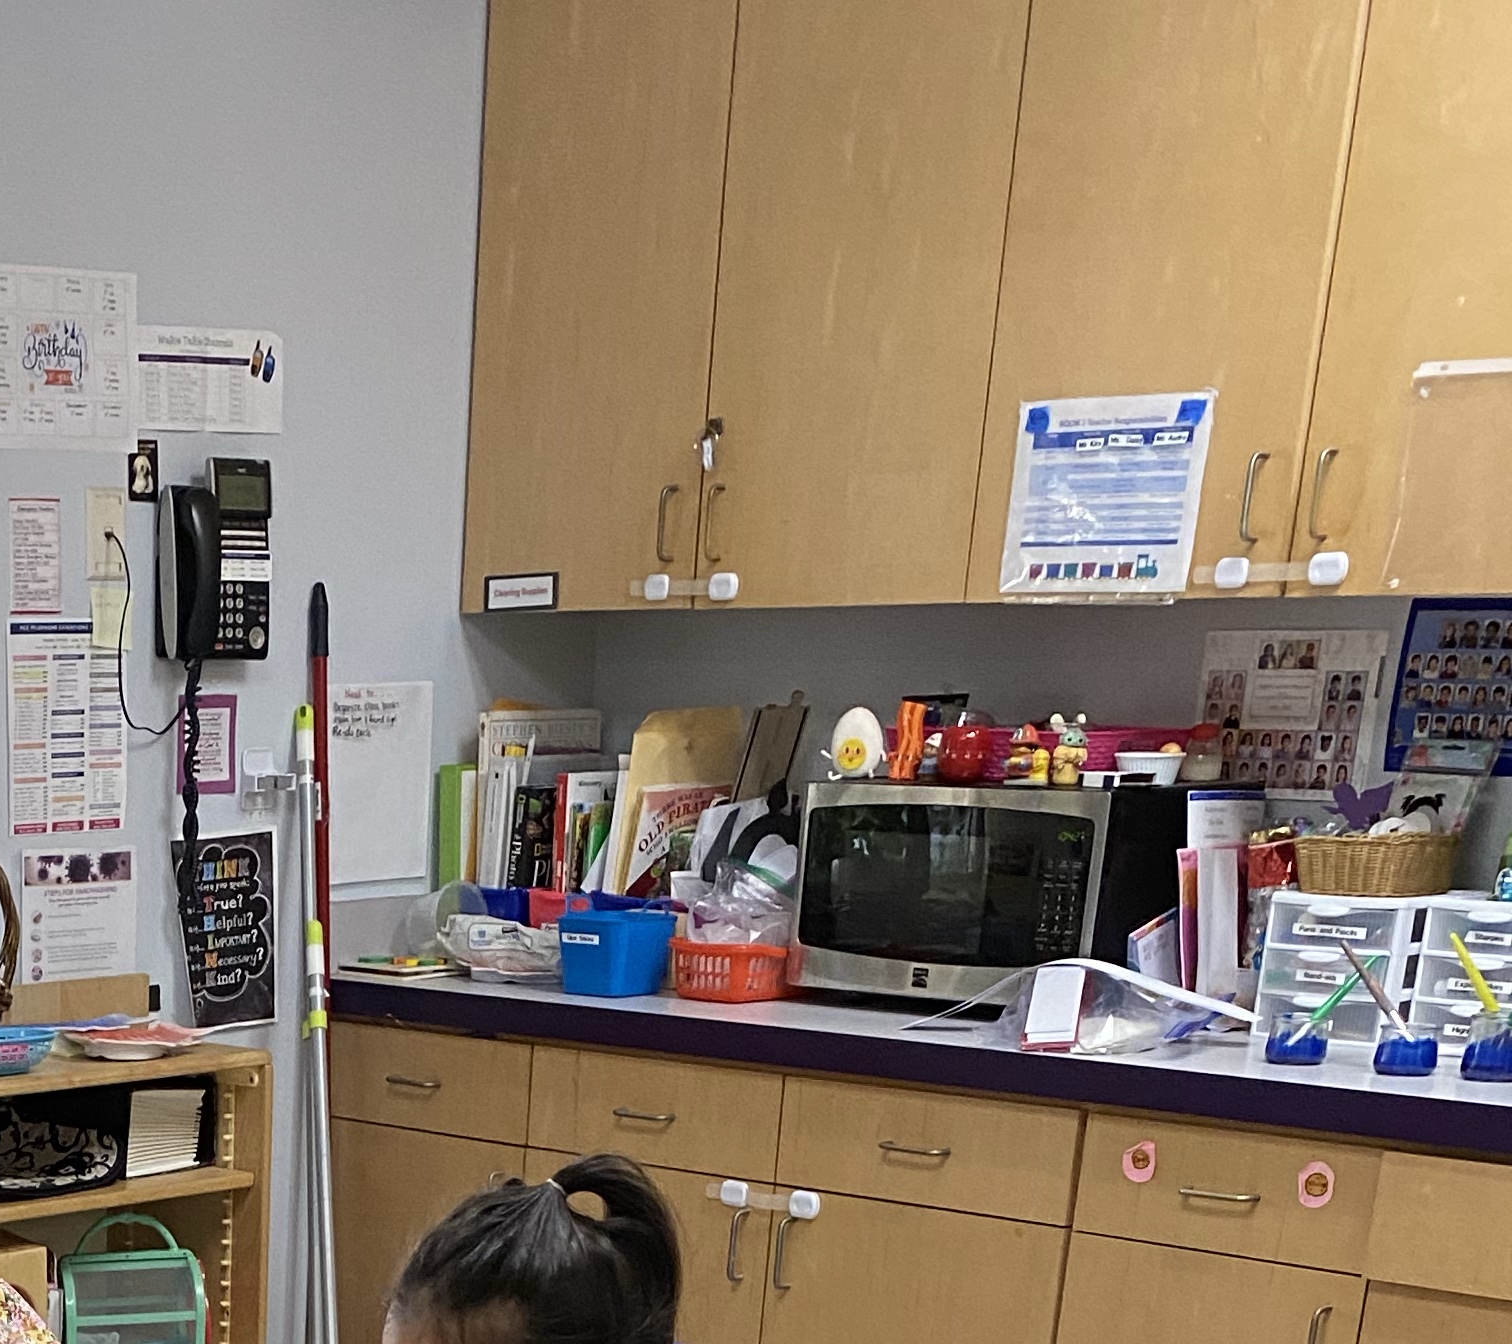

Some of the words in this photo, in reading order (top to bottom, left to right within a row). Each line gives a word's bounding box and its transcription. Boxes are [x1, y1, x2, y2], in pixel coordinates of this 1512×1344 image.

[492, 723, 542, 737] STEPHEN
[638, 821, 665, 852] OLD
[668, 800, 708, 823] PIRAT
[203, 893, 243, 913] True?
[203, 911, 253, 932] Helpful?
[204, 947, 264, 968] Necessary?
[205, 968, 242, 988] Kind?
